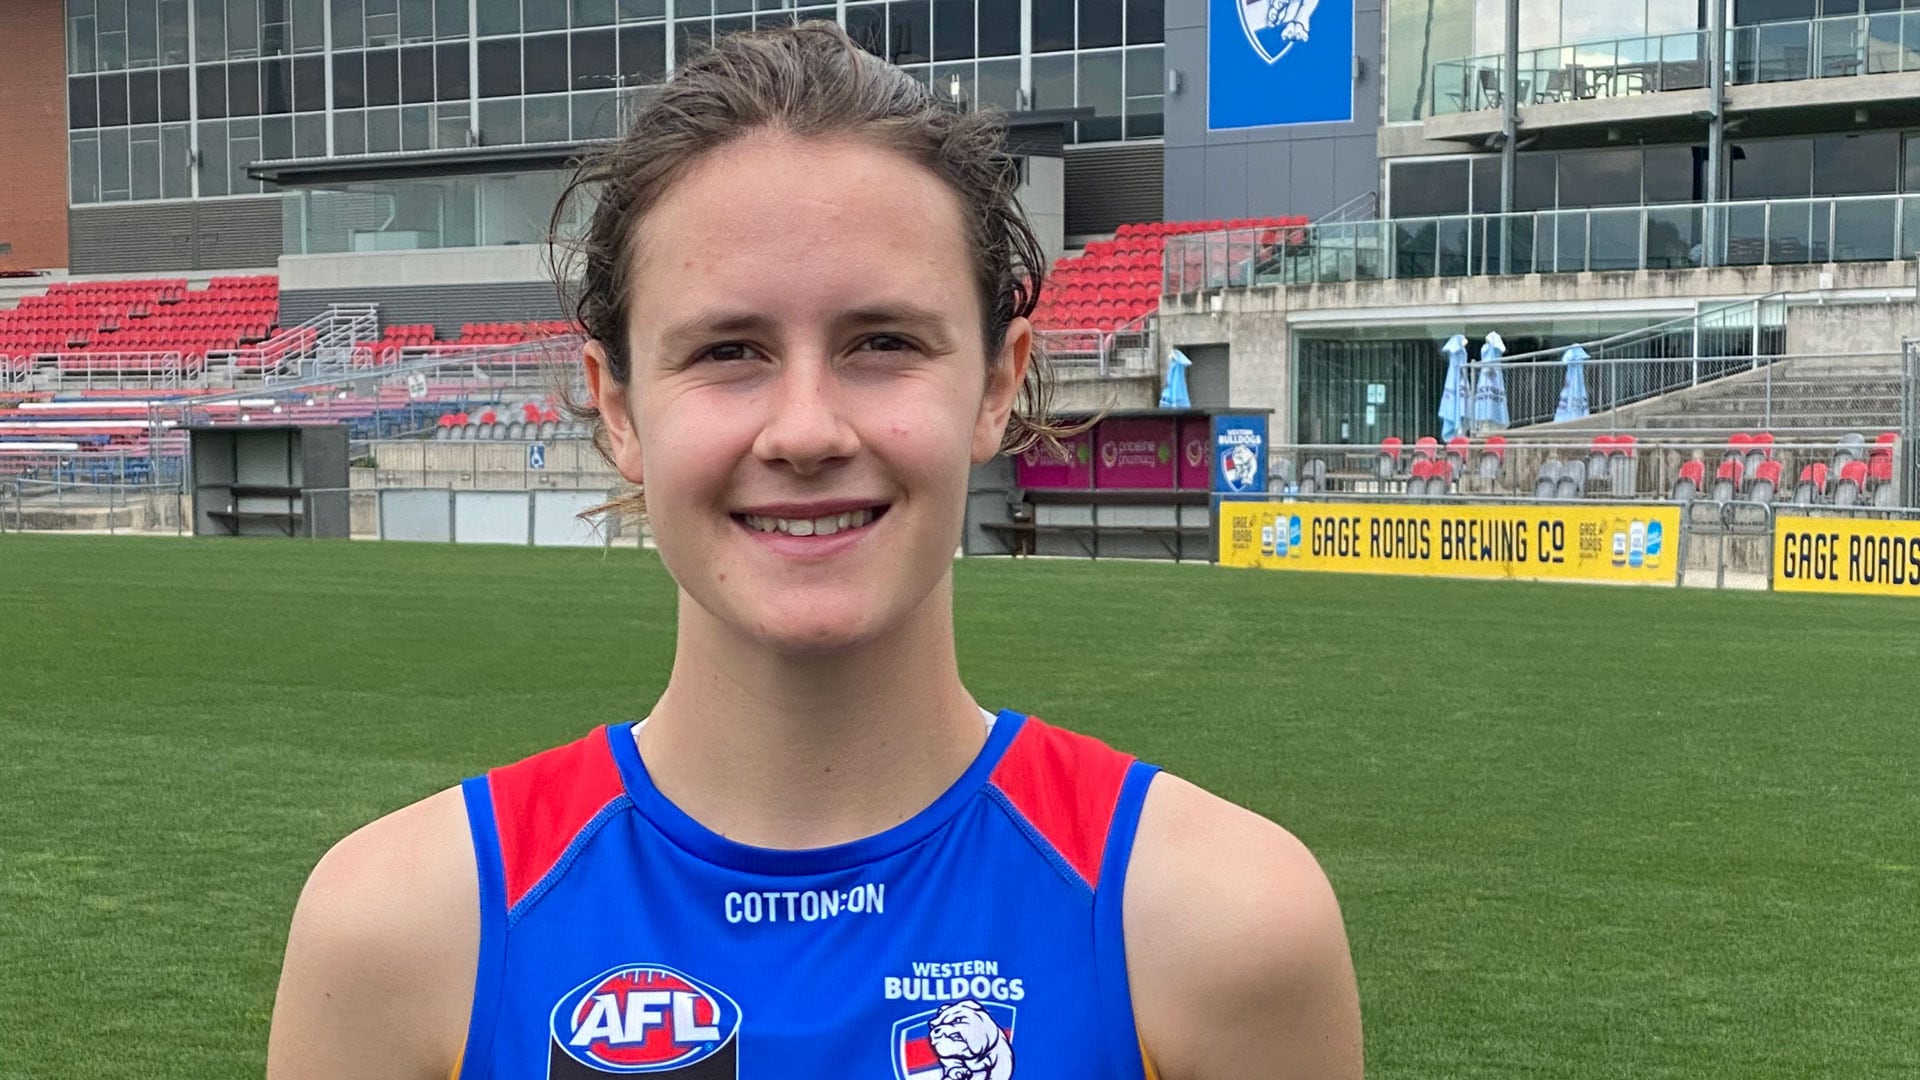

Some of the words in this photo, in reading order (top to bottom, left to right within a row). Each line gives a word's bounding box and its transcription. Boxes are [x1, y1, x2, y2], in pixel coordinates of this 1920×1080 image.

[1312, 517, 1361, 557] GAGE
[1371, 518, 1430, 560] ROADS
[1441, 519, 1527, 562] BREWING
[1784, 532, 1839, 580] GAGE
[1850, 534, 1920, 585] ROADS
[884, 976, 1025, 1001] BULLDOGS
[912, 960, 998, 978] WESTERN
[569, 991, 721, 1046] AFL
